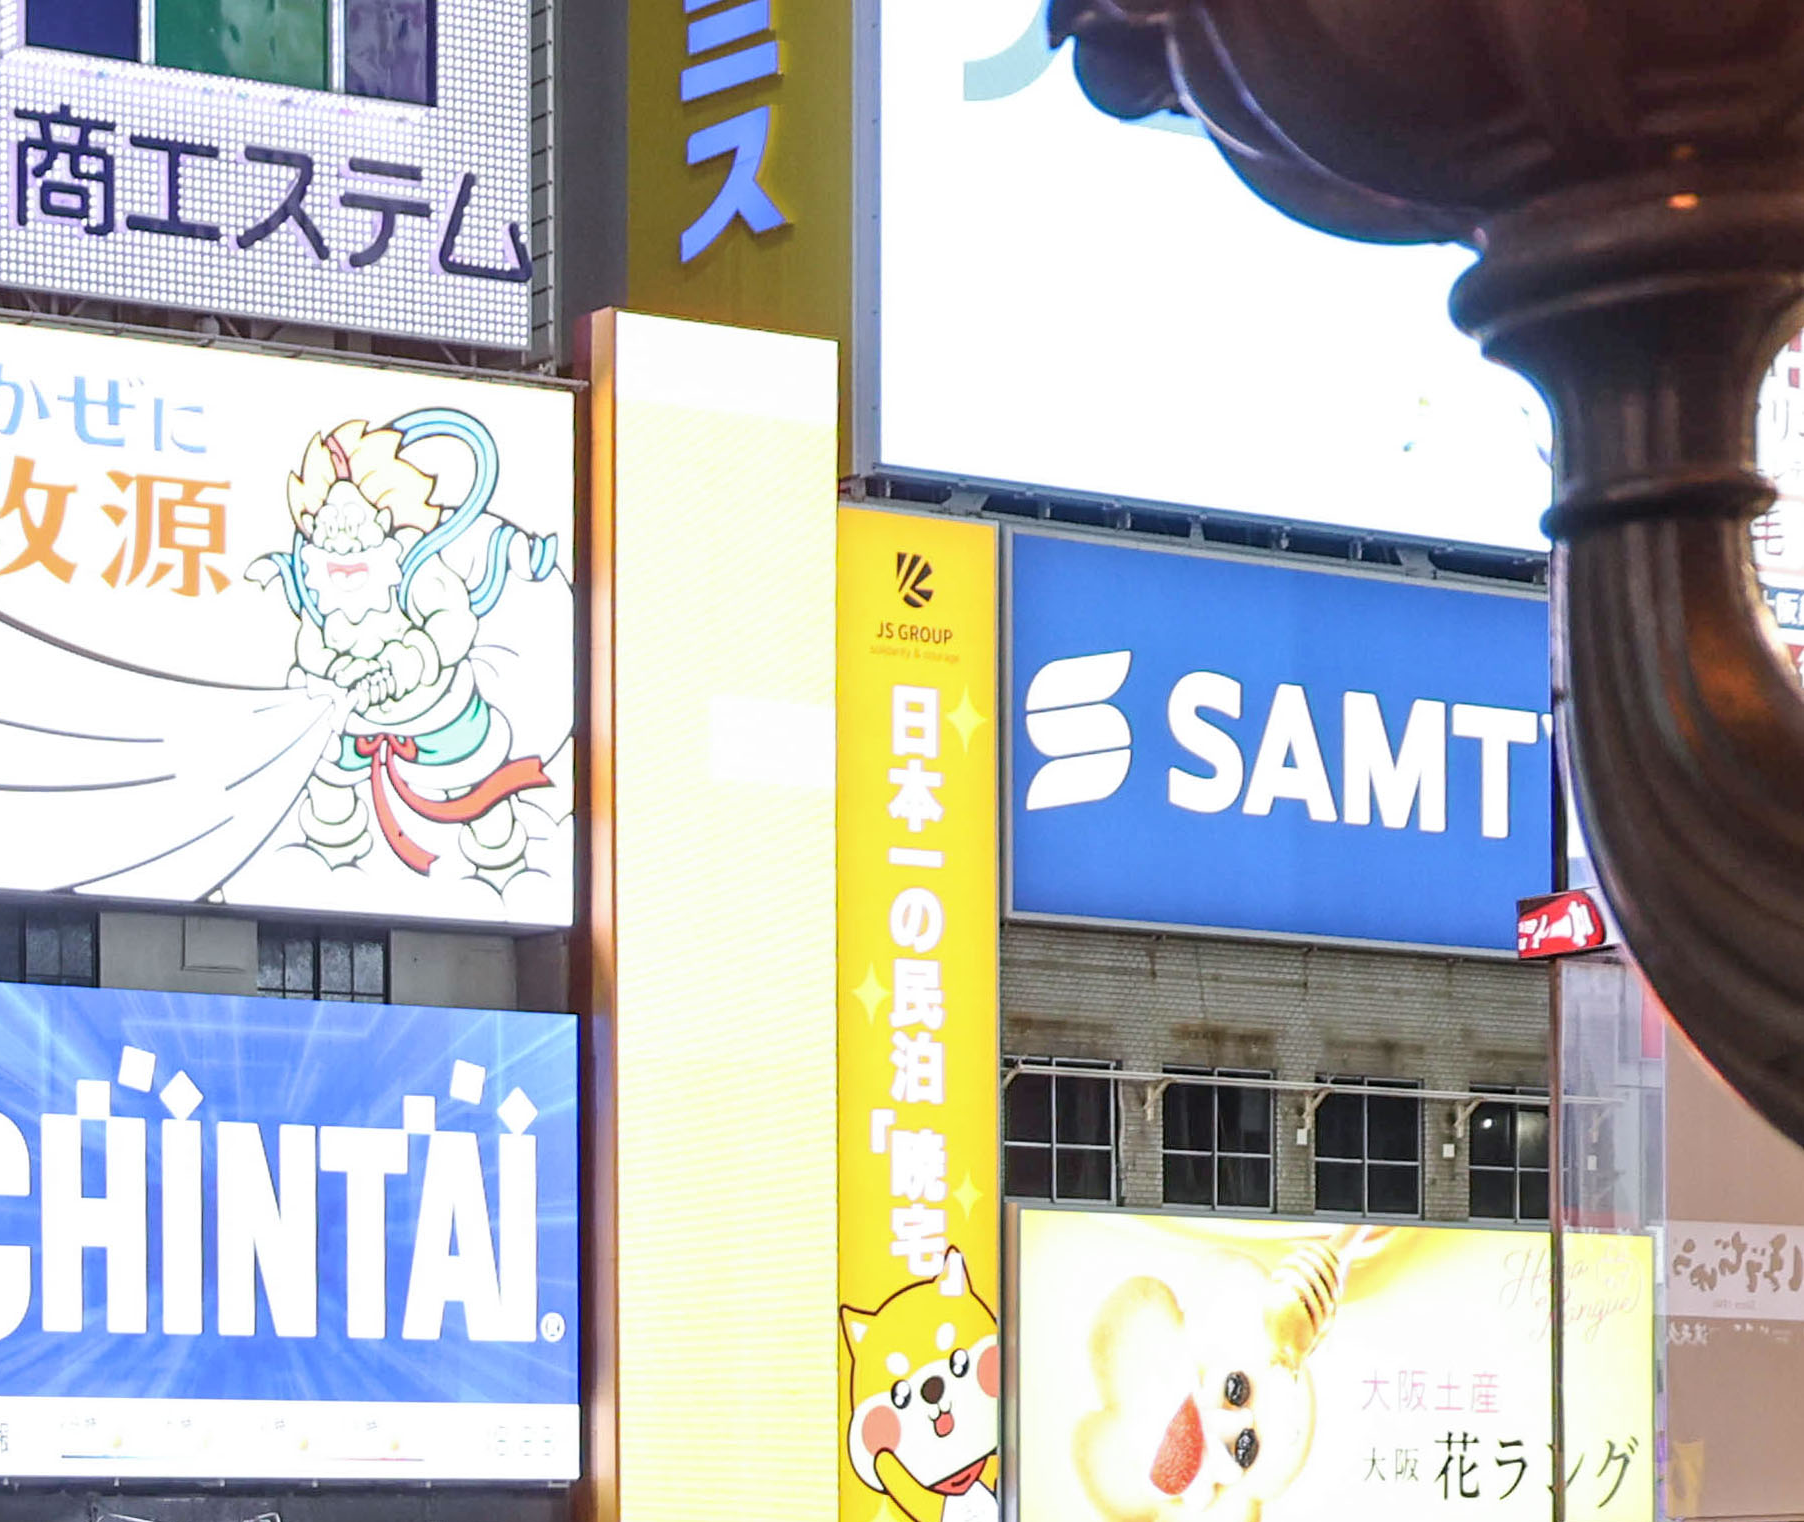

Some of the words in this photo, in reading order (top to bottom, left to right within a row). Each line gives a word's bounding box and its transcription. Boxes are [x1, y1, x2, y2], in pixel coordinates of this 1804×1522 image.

[875, 621, 895, 641] JS
[898, 623, 954, 646] GROUP
[1167, 670, 1552, 840] SAMT
[1360, 1369, 1502, 1414] 大阪土産
[1363, 1448, 1421, 1485] 大阪
